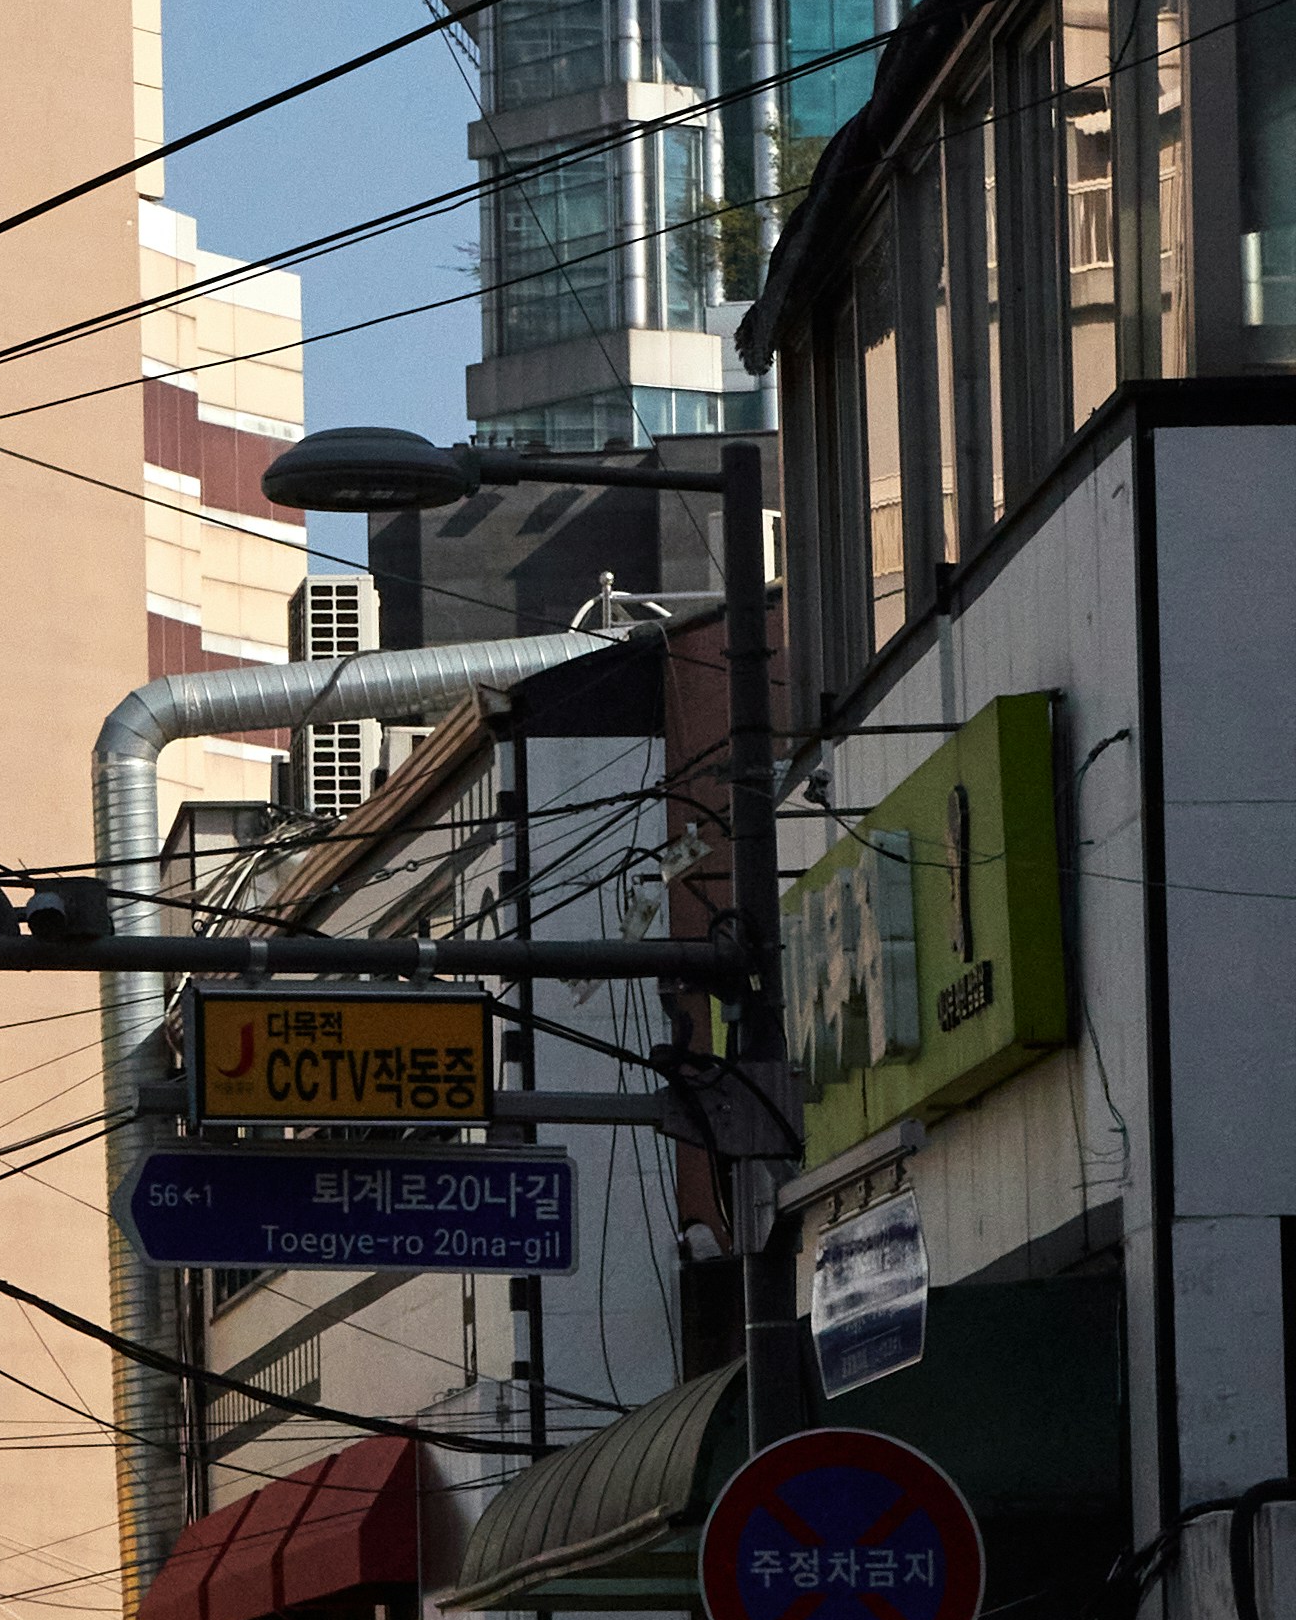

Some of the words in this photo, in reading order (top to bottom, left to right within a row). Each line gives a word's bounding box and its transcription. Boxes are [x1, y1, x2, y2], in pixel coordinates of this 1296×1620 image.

[267, 1010, 343, 1044] 다목적
[267, 1046, 476, 1110] CCTV작동중
[312, 1168, 560, 1221] 퇴계로20나길
[261, 1225, 424, 1260] Toegye-ro
[434, 1228, 560, 1264] 20na-gil
[750, 1547, 935, 1589] 주정차금지
